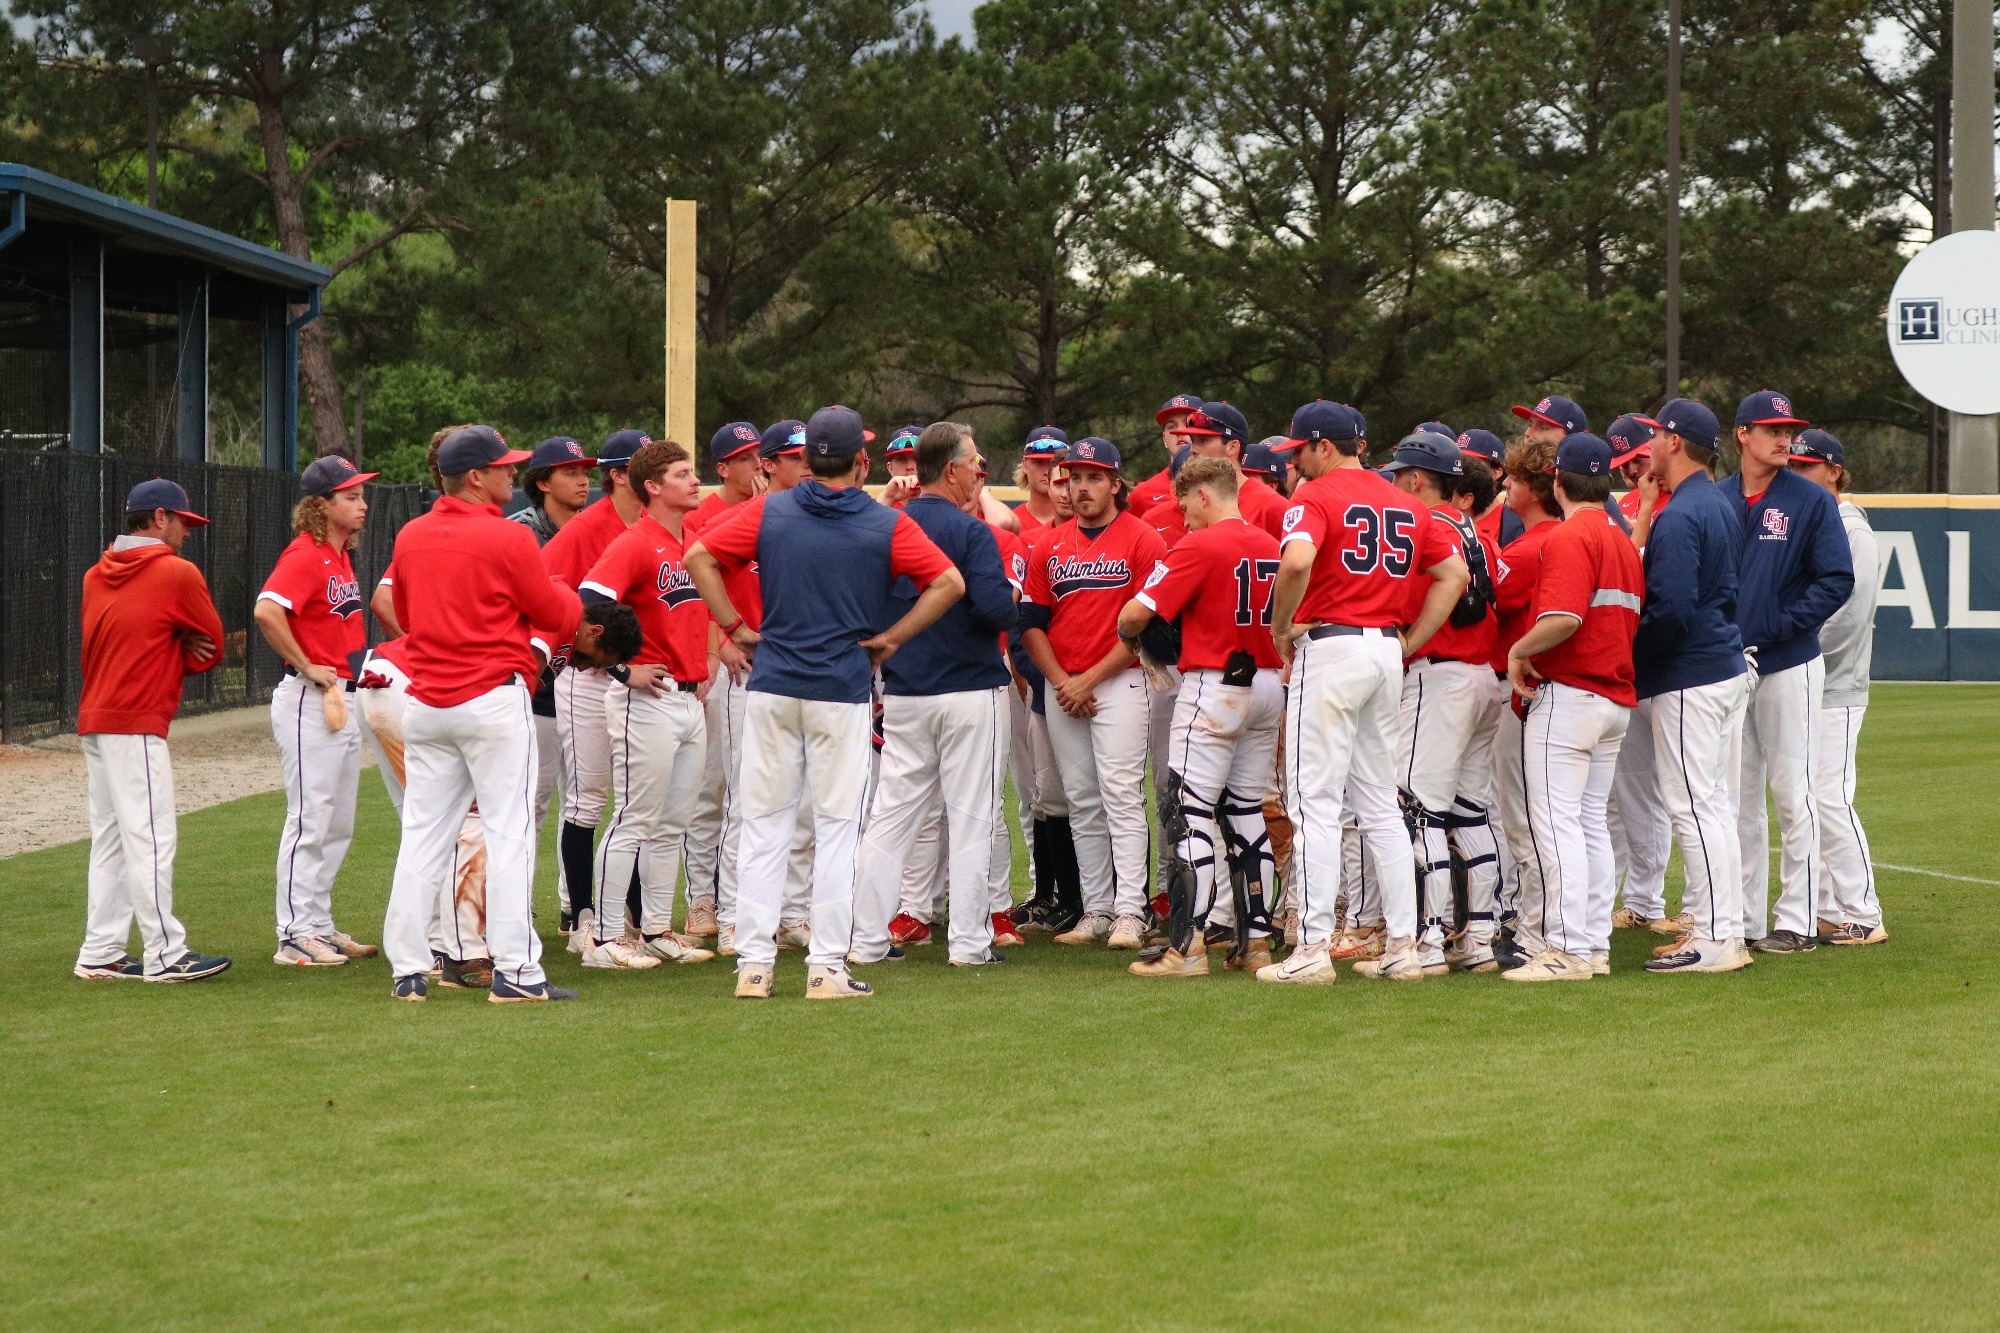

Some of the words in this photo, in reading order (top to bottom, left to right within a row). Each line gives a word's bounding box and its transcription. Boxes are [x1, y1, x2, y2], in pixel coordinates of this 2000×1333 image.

[1947, 307, 2000, 327] UGH
[1946, 329, 2000, 345] CLINI
[1763, 508, 1789, 535] CSU
[1341, 503, 1416, 579] 35
[1046, 552, 1130, 584] Columbus
[1233, 557, 1281, 627] 17
